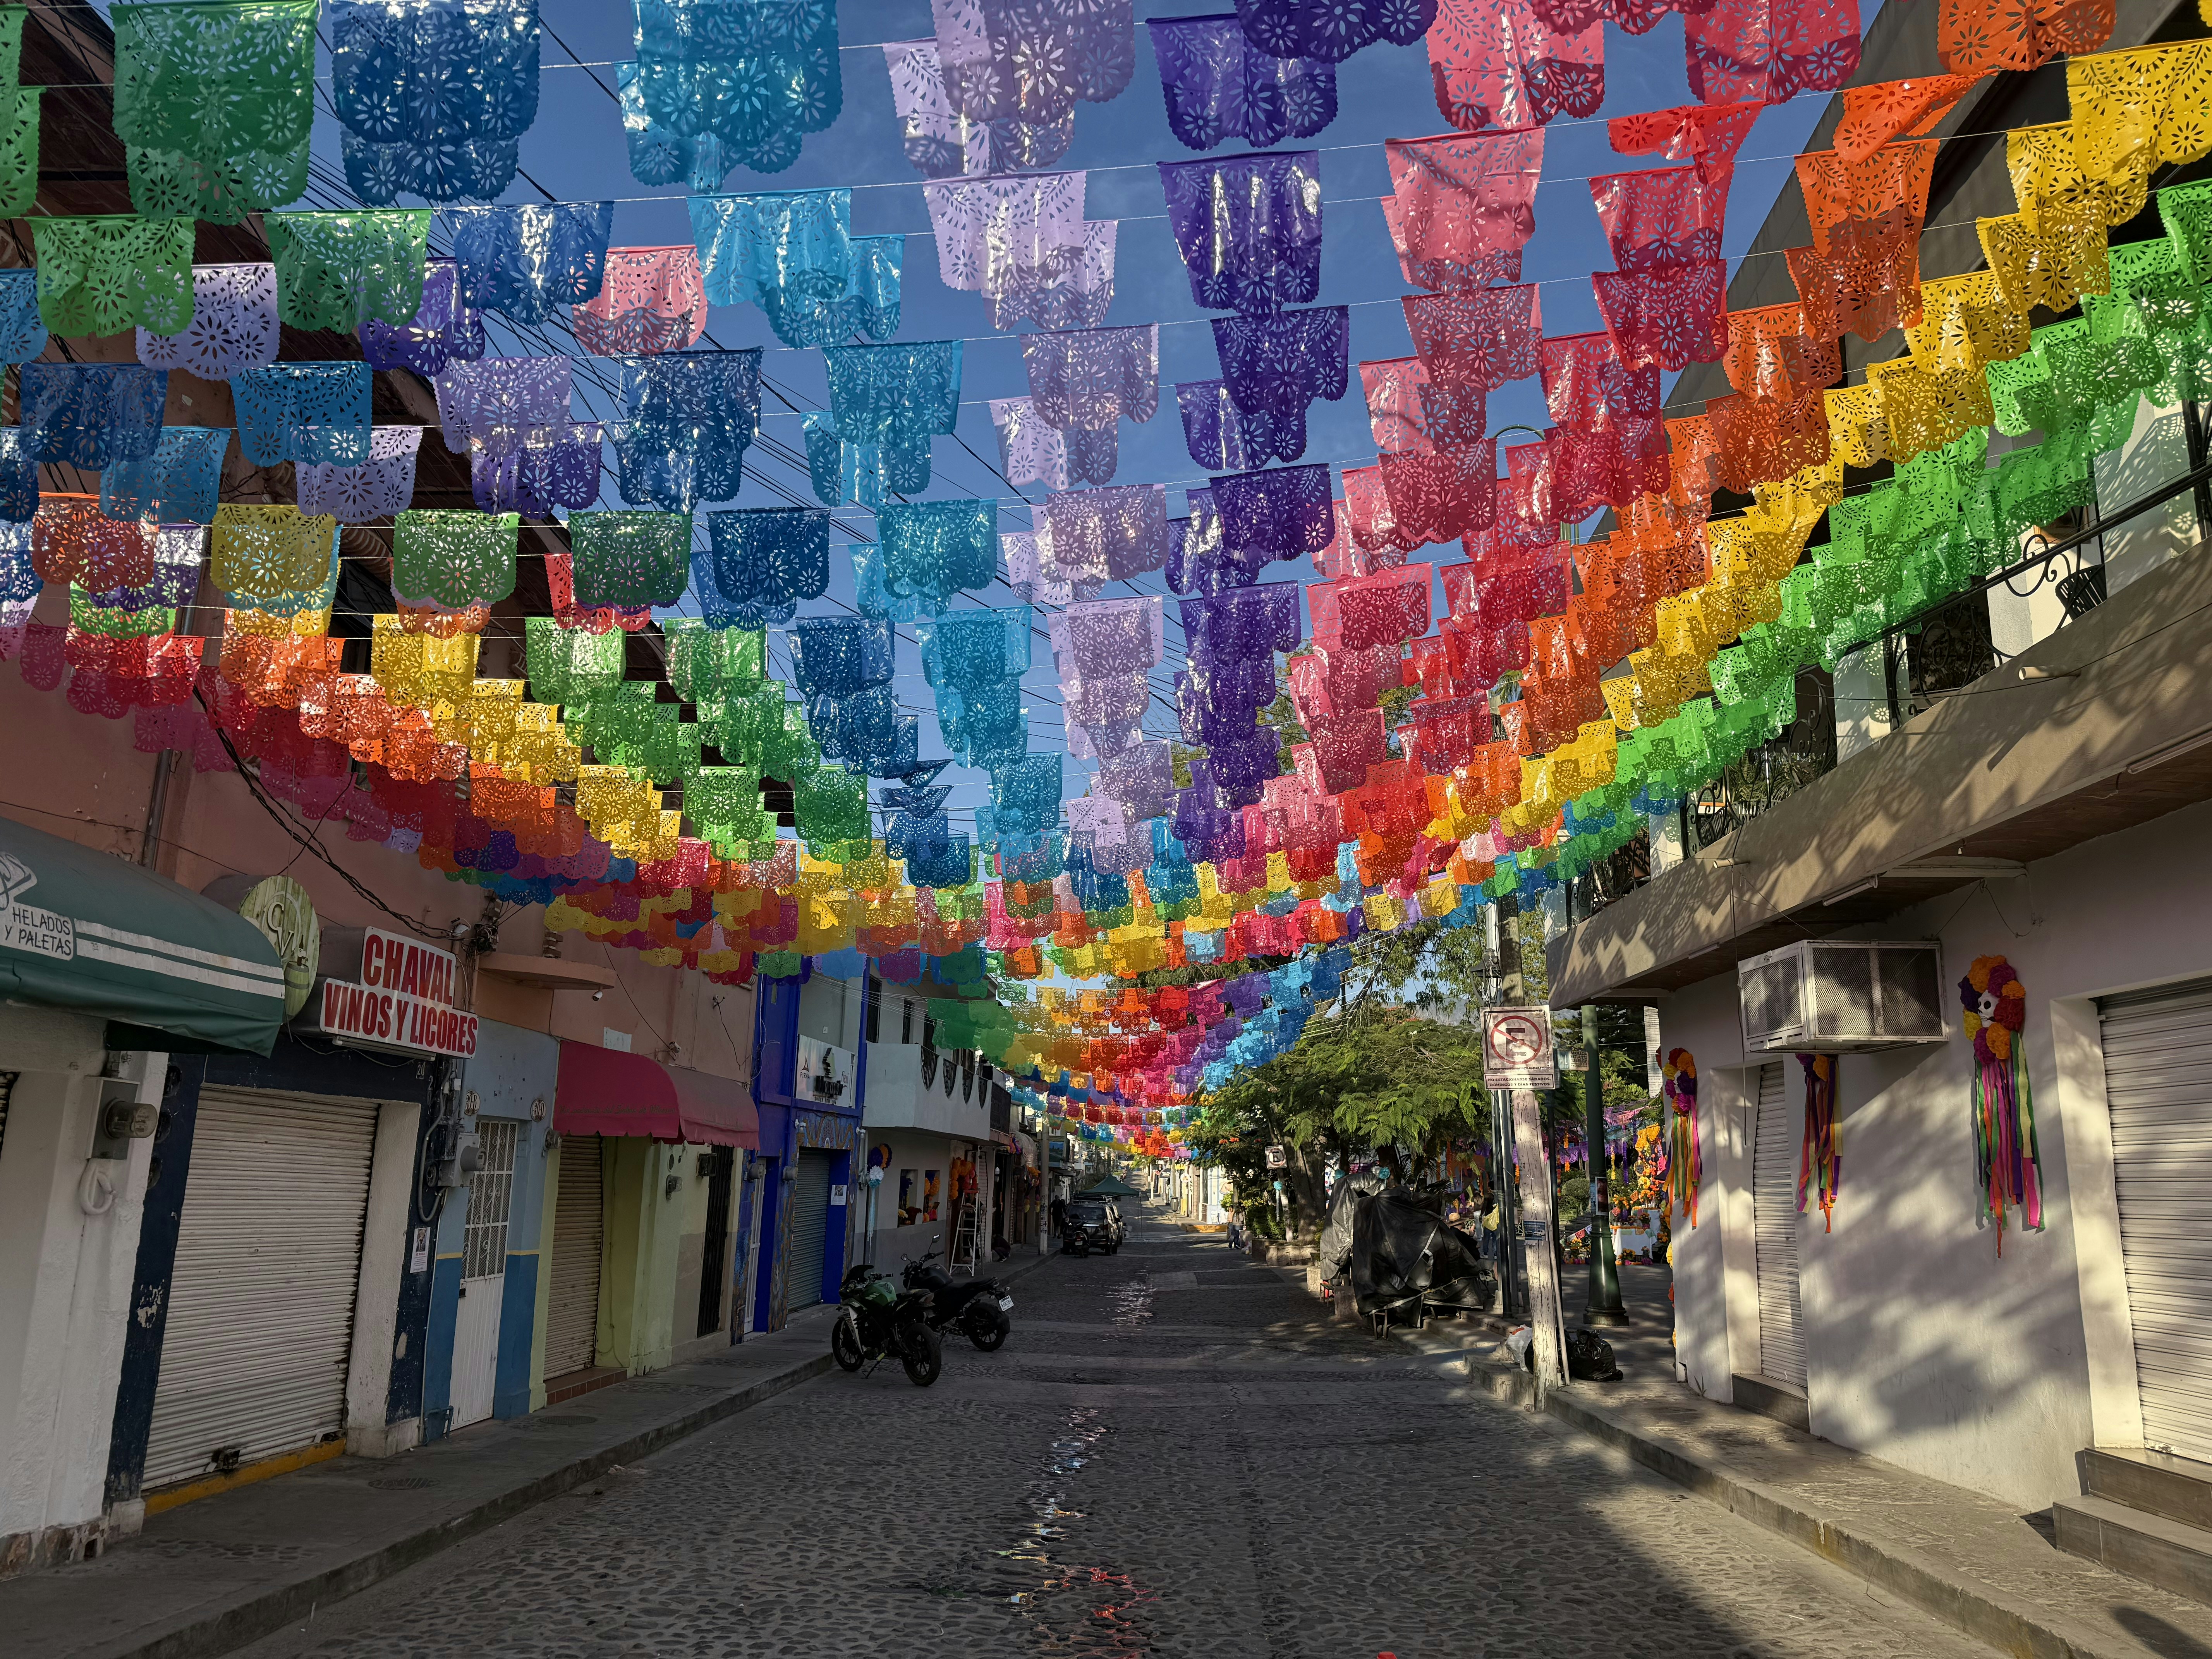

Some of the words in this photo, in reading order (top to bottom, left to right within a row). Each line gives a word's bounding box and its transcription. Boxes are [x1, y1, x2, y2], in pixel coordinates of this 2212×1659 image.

[12, 907, 70, 936] HELADOS
[19, 928, 71, 956] PALETAS
[363, 934, 452, 1005] CHAVAL
[324, 982, 393, 1038] VINOS
[394, 999, 409, 1041] Y
[410, 1003, 476, 1055] LICORES
